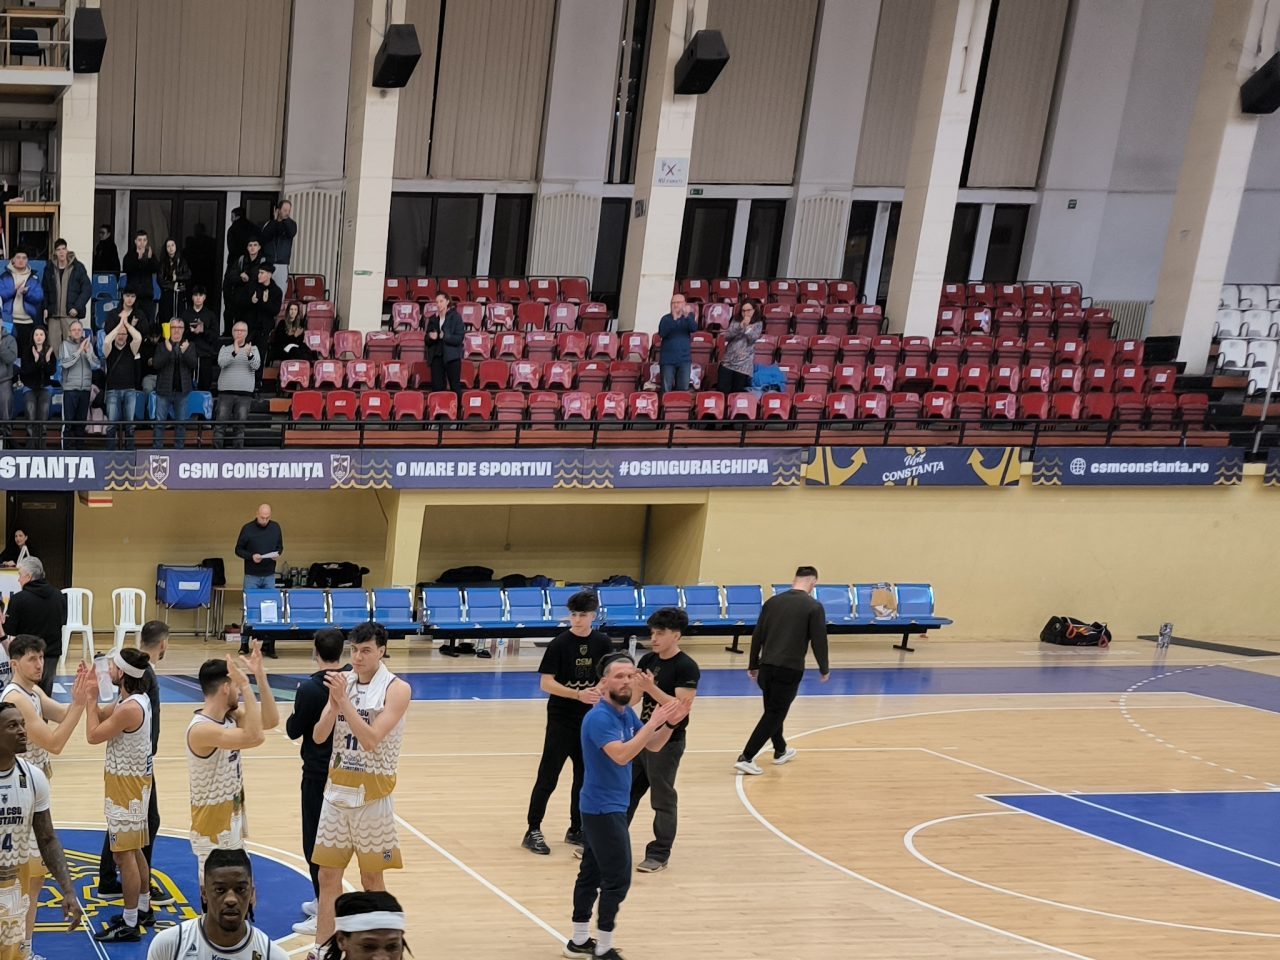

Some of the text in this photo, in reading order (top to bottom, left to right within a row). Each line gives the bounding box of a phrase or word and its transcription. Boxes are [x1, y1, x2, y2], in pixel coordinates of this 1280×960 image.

[178, 462, 324, 481] CSM CONSTANȚA
[396, 462, 552, 477] O MARE DE SPORTIVI
[619, 459, 769, 475] #OSINGURAECHIPA
[1090, 460, 1209, 474] csmconstanta.ro
[344, 733, 358, 750] 11
